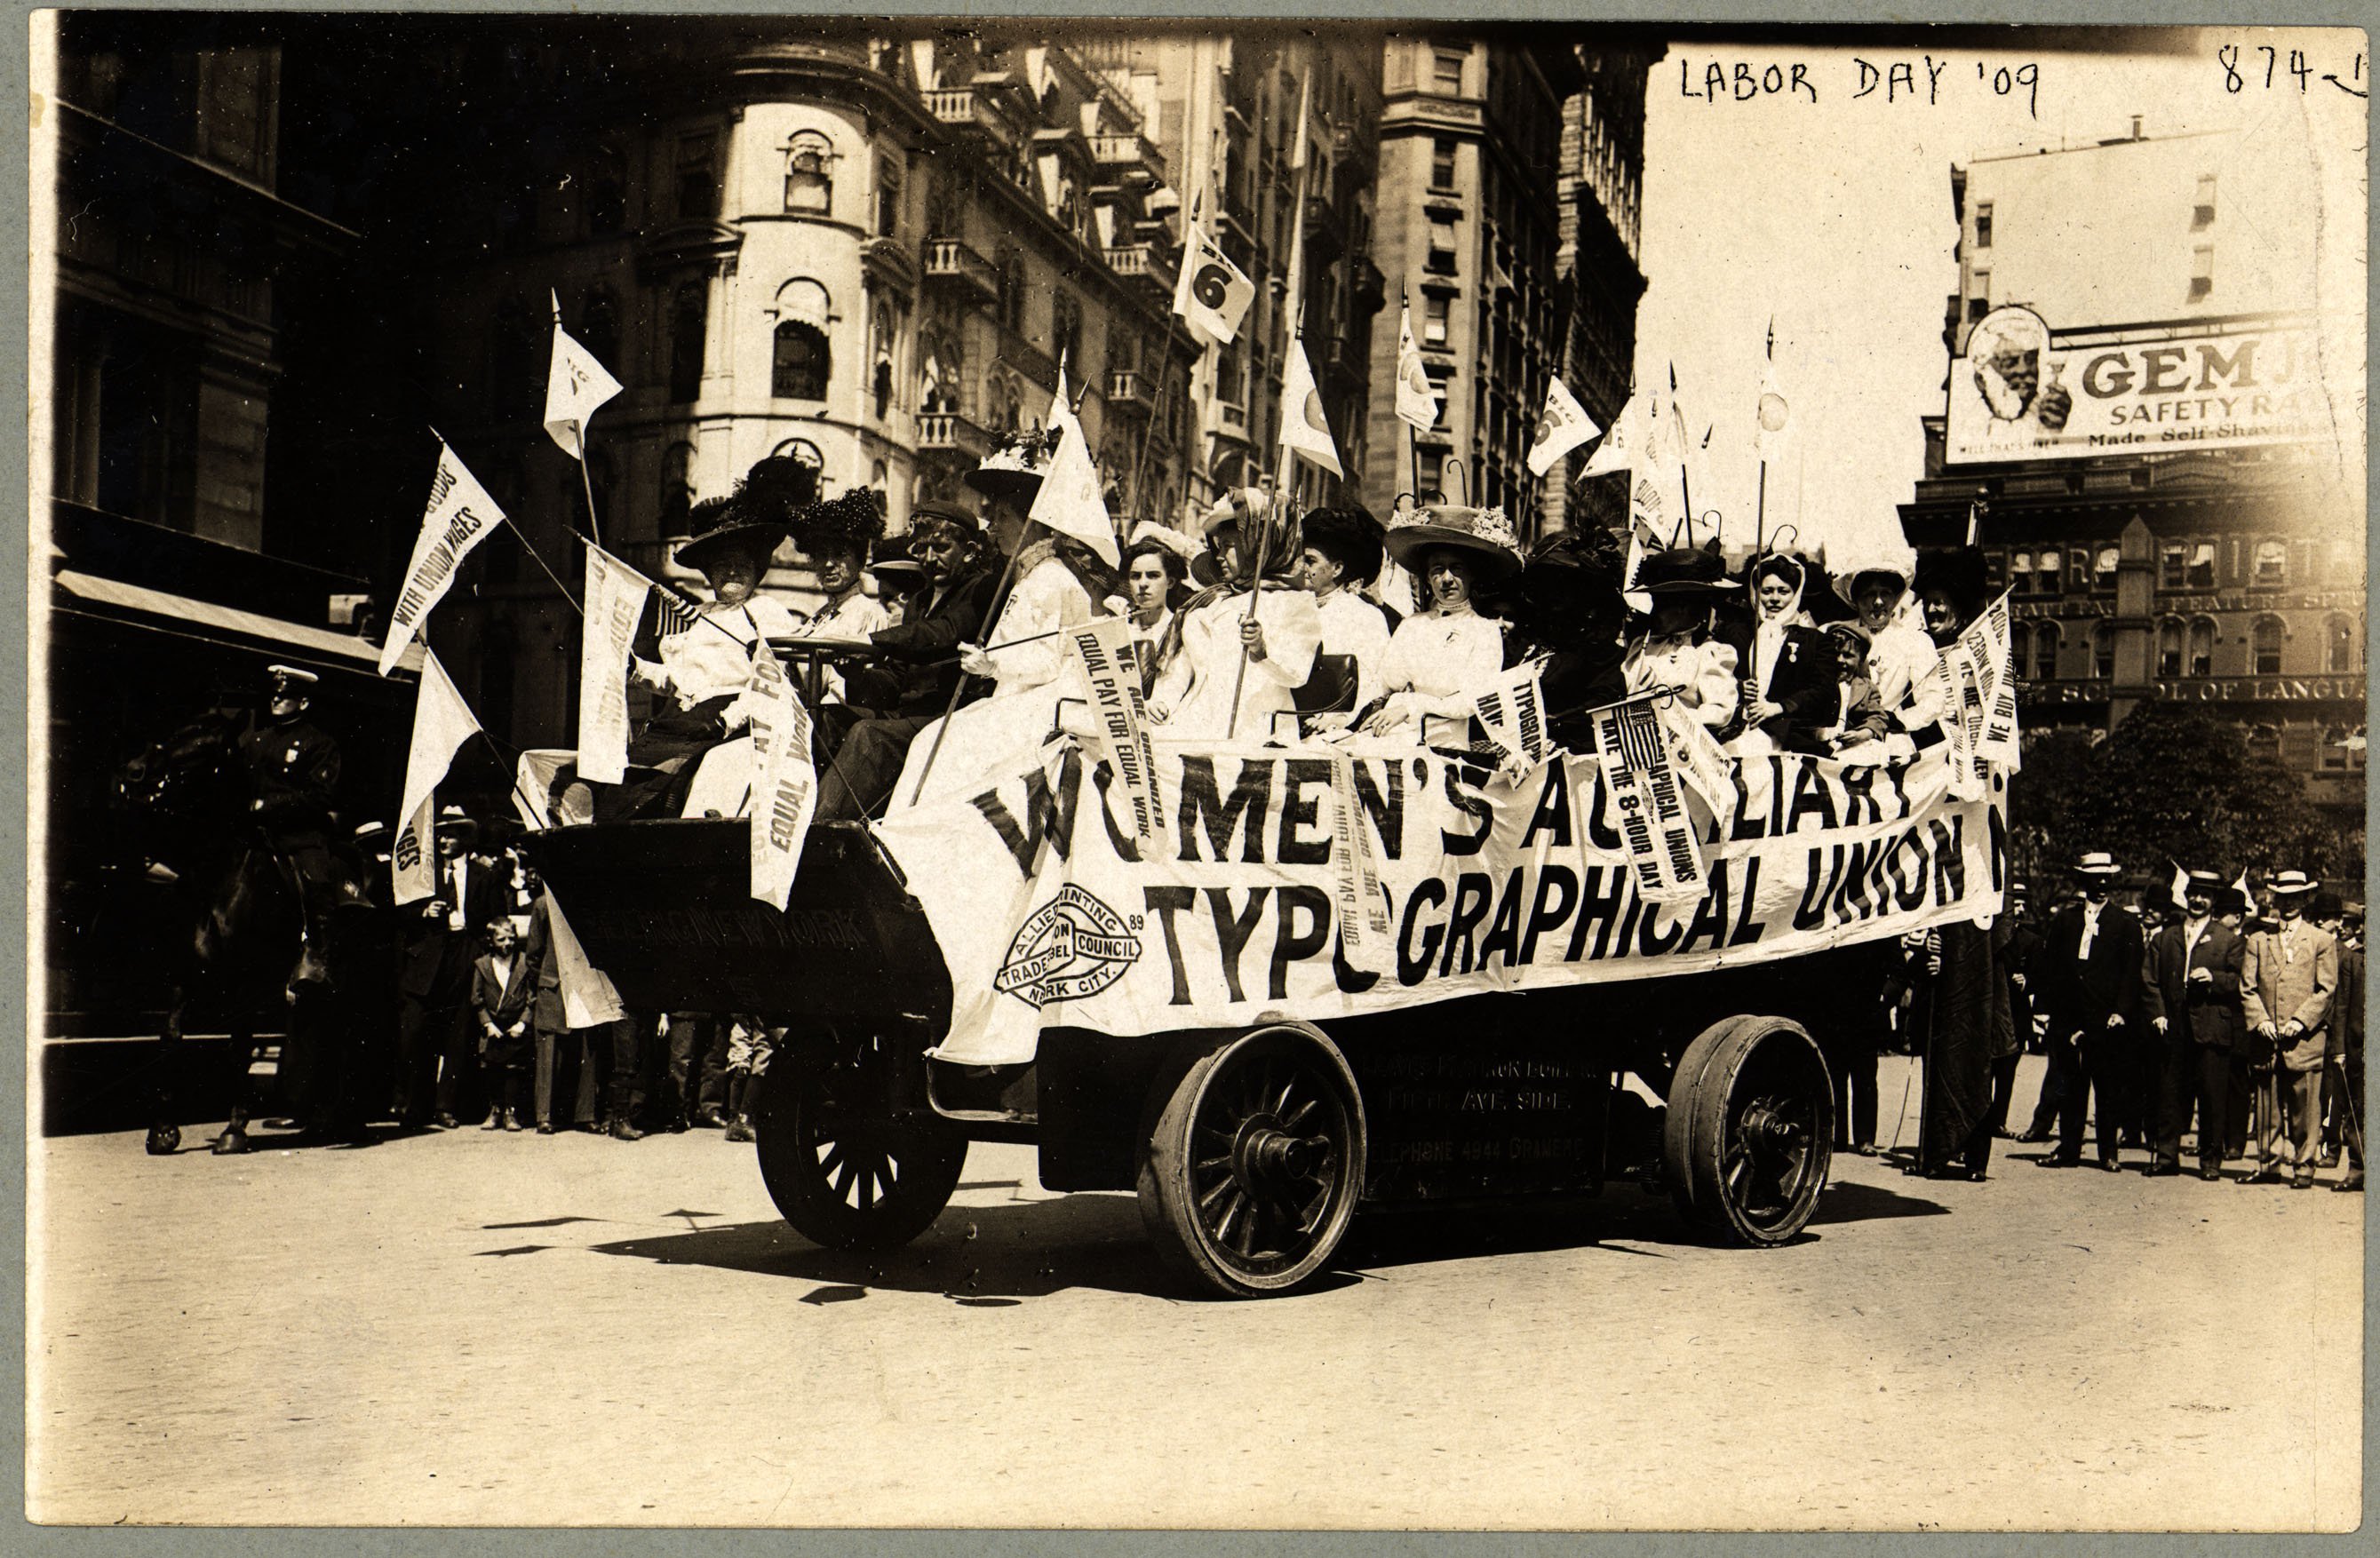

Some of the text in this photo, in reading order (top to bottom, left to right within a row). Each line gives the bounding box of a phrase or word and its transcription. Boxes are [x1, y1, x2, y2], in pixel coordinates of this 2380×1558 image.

[1192, 263, 1233, 310] 6
[2082, 339, 2262, 399] GEM
[1548, 393, 1576, 425] BIG
[2110, 396, 2240, 426] SAFETY
[2089, 432, 2146, 447] Made
[394, 505, 482, 628] WITH UNION WAGES
[1963, 685, 1981, 711] ARE
[1994, 692, 2015, 719] BUY
[2200, 682, 2238, 701] OF
[2254, 680, 2367, 700] LANGU
[1073, 632, 1151, 839] EQUAL PAY FOR EQUAL WORK
[1116, 643, 1166, 830] WE ARE ORGANIZED
[1986, 722, 2011, 743] WE
[770, 778, 810, 854] EQUAL
[1519, 751, 1922, 850] AULIARY
[1601, 718, 1664, 889] HAVE THE 8-HOUR DAY
[1664, 827, 1698, 885] UNIONS
[1792, 814, 1965, 931] UNION
[1015, 888, 1118, 956] ALLIED INTING
[1129, 914, 1144, 931] 89
[1002, 934, 1135, 986] TRADE COUNCIL
[1079, 966, 1117, 993] CITY.
